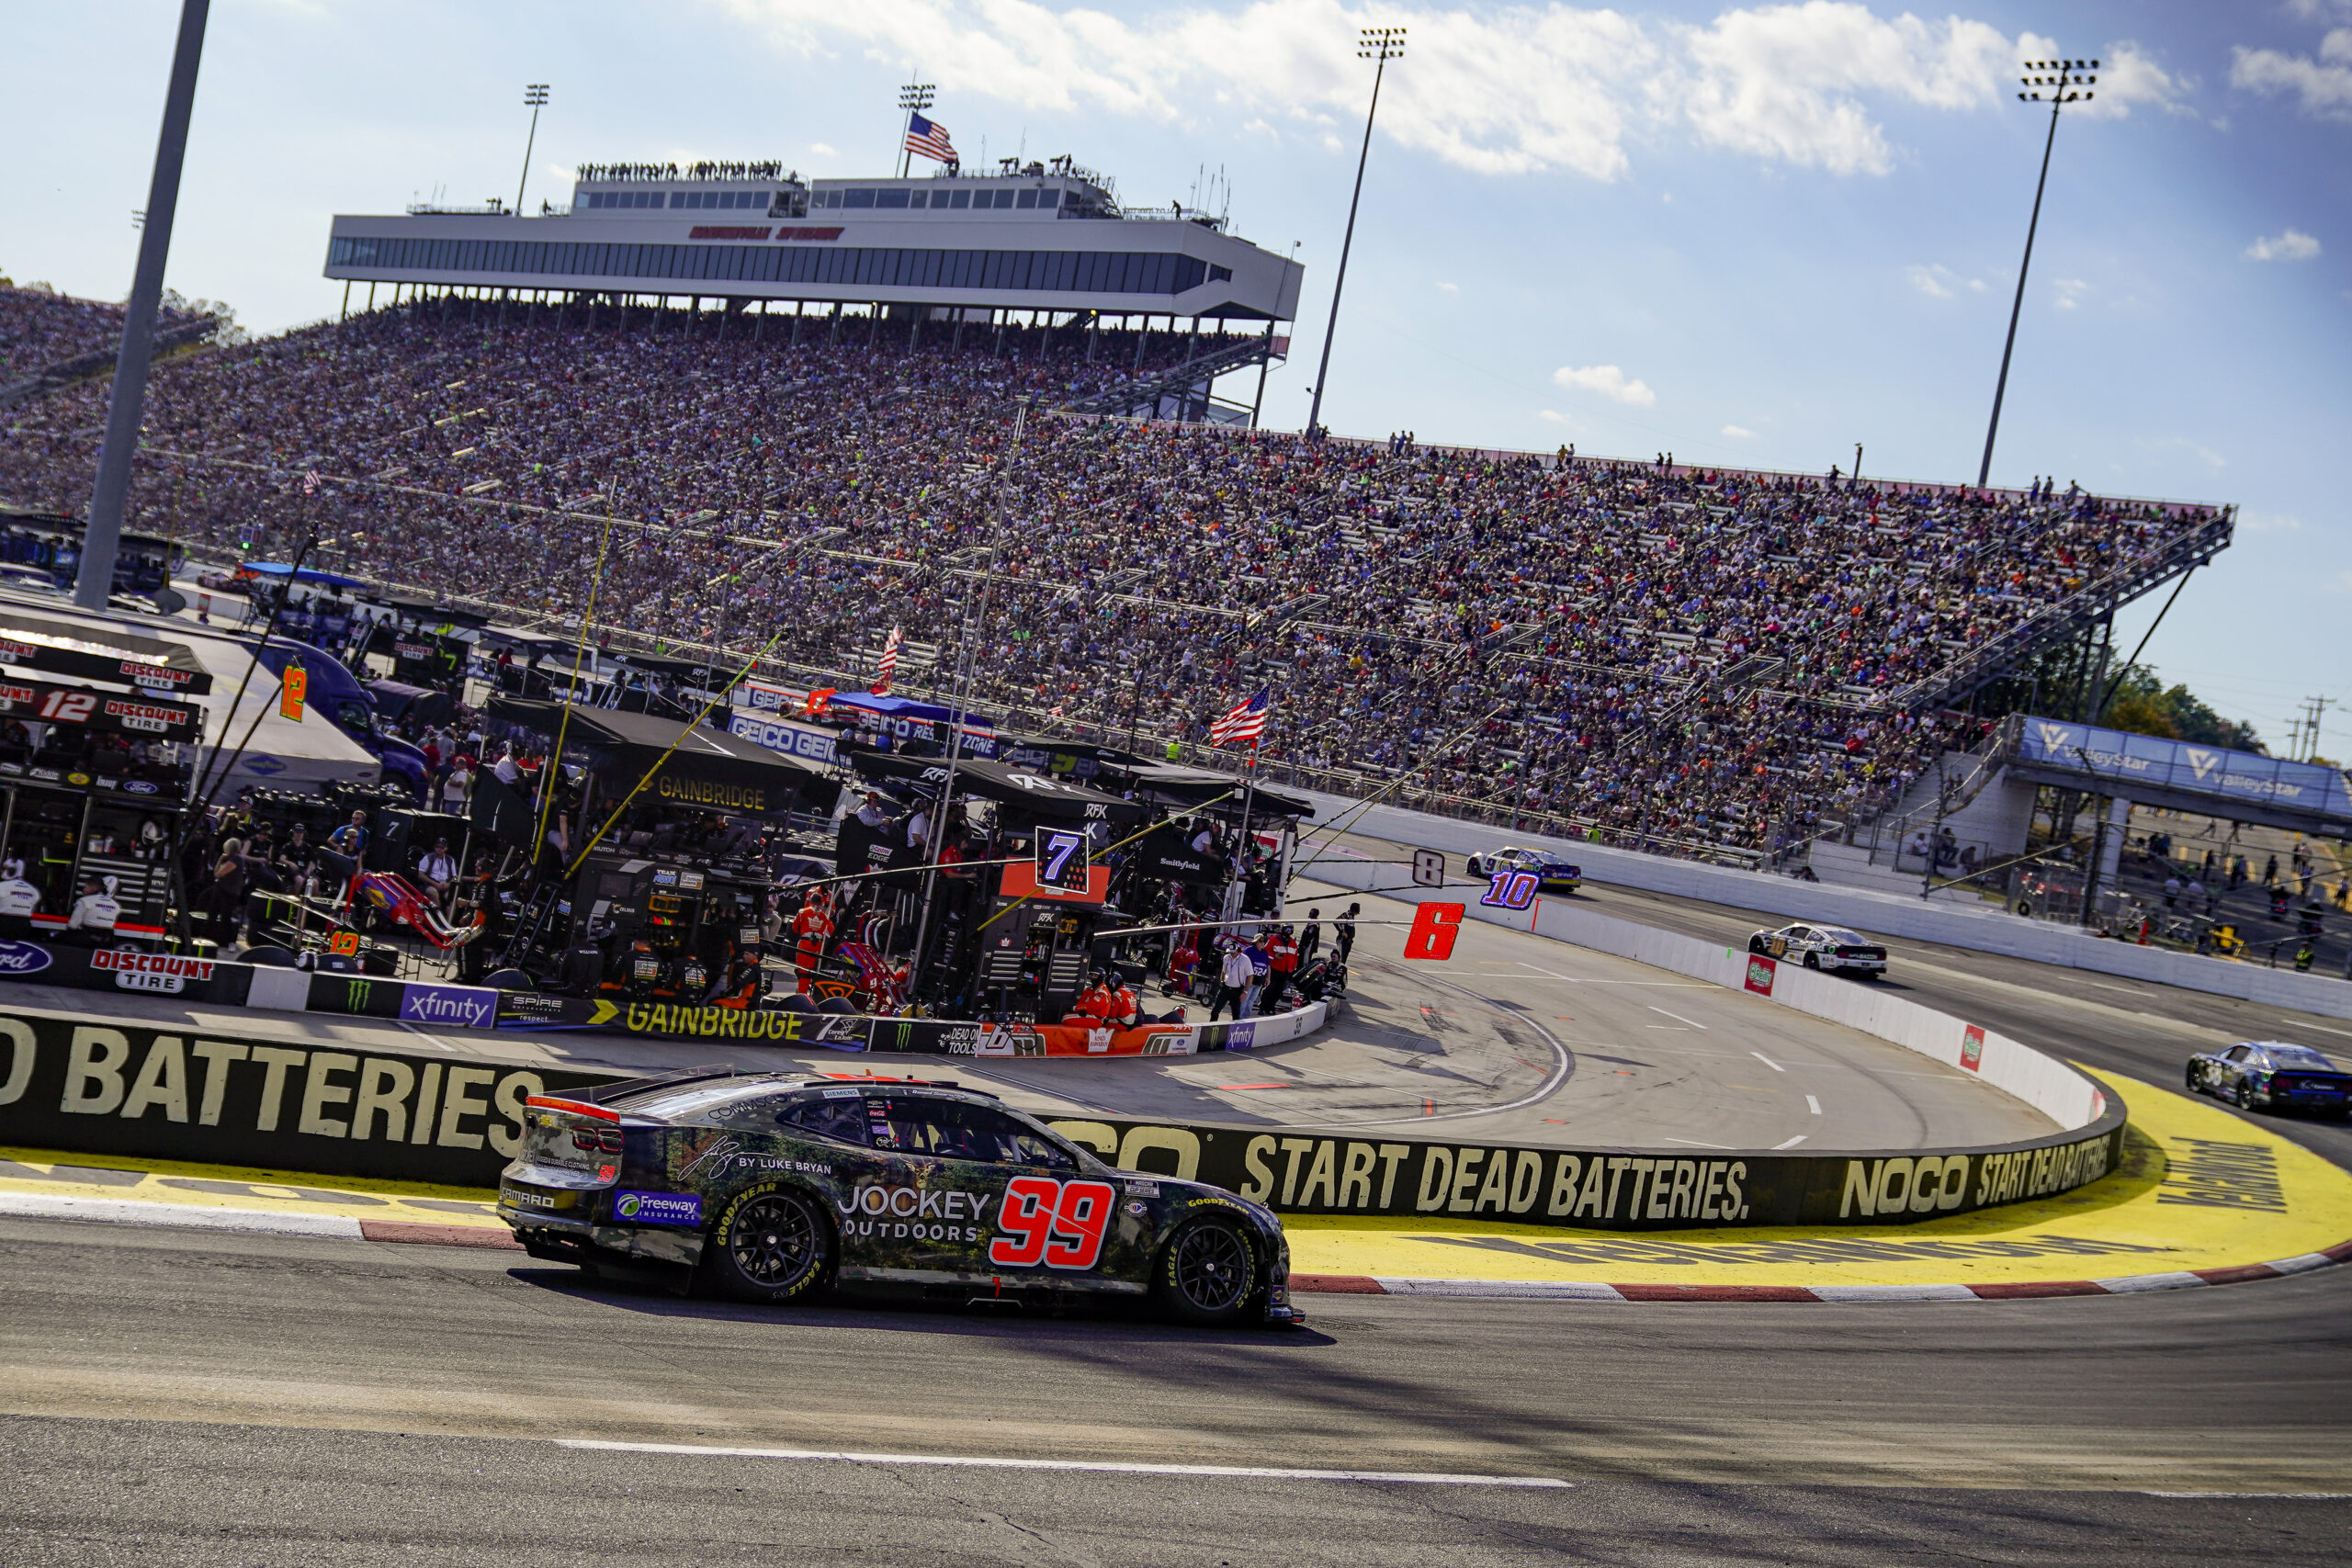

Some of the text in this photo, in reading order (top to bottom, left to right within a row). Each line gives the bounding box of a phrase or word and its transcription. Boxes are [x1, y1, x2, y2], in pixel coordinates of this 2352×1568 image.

[119, 661, 192, 684] DISCOUNT
[139, 676, 169, 688] TIRE
[279, 664, 308, 723] 12
[40, 691, 97, 723] 12
[105, 699, 187, 724] DISCOUNT
[127, 716, 163, 730] TIRE
[732, 716, 793, 750] GEICO
[660, 776, 764, 810] GAINBRIDGE
[1084, 804, 1108, 818] RFK
[867, 852, 890, 862] EDGE
[1046, 834, 1080, 880] 7
[1160, 857, 1200, 871] Smithfield
[1484, 858, 1497, 871] 9
[1480, 869, 1540, 910] 10
[329, 931, 359, 957] 12
[1404, 902, 1465, 960] 6
[91, 949, 213, 980] DISCOUNT
[125, 974, 175, 989] TIRE
[409, 992, 490, 1025] xfinity
[628, 1002, 804, 1041] GAINBRIDGE
[816, 1016, 840, 1042] 7
[950, 1027, 970, 1040] DEAD
[1229, 1024, 1253, 1048] xfinity
[948, 1042, 978, 1055] TOOLS
[60, 1026, 544, 1159] BATTERIES
[707, 1091, 802, 1119] COMMSCOPE
[825, 1089, 858, 1098] SIEMENS
[596, 1165, 616, 1182] 99
[740, 1157, 831, 1175] BY LUKE BRYAN
[1240, 1134, 1750, 1221] START DEAD BATTERIES.
[1839, 1155, 1969, 1218] NOCO
[1976, 1151, 2032, 1206] START
[2027, 1145, 2066, 1194] DEAD
[502, 1187, 555, 1208] CAMARO
[640, 1195, 697, 1214] Freeway
[838, 1186, 990, 1221] JOCKEY
[1188, 1198, 1250, 1215] GOODYEAR
[639, 1211, 695, 1221] INSURANCE
[718, 1182, 777, 1247] GOODYEAR
[988, 1175, 1116, 1270] 99
[788, 1259, 820, 1297] EAGLE
[1169, 1245, 1179, 1287] EAGLE
